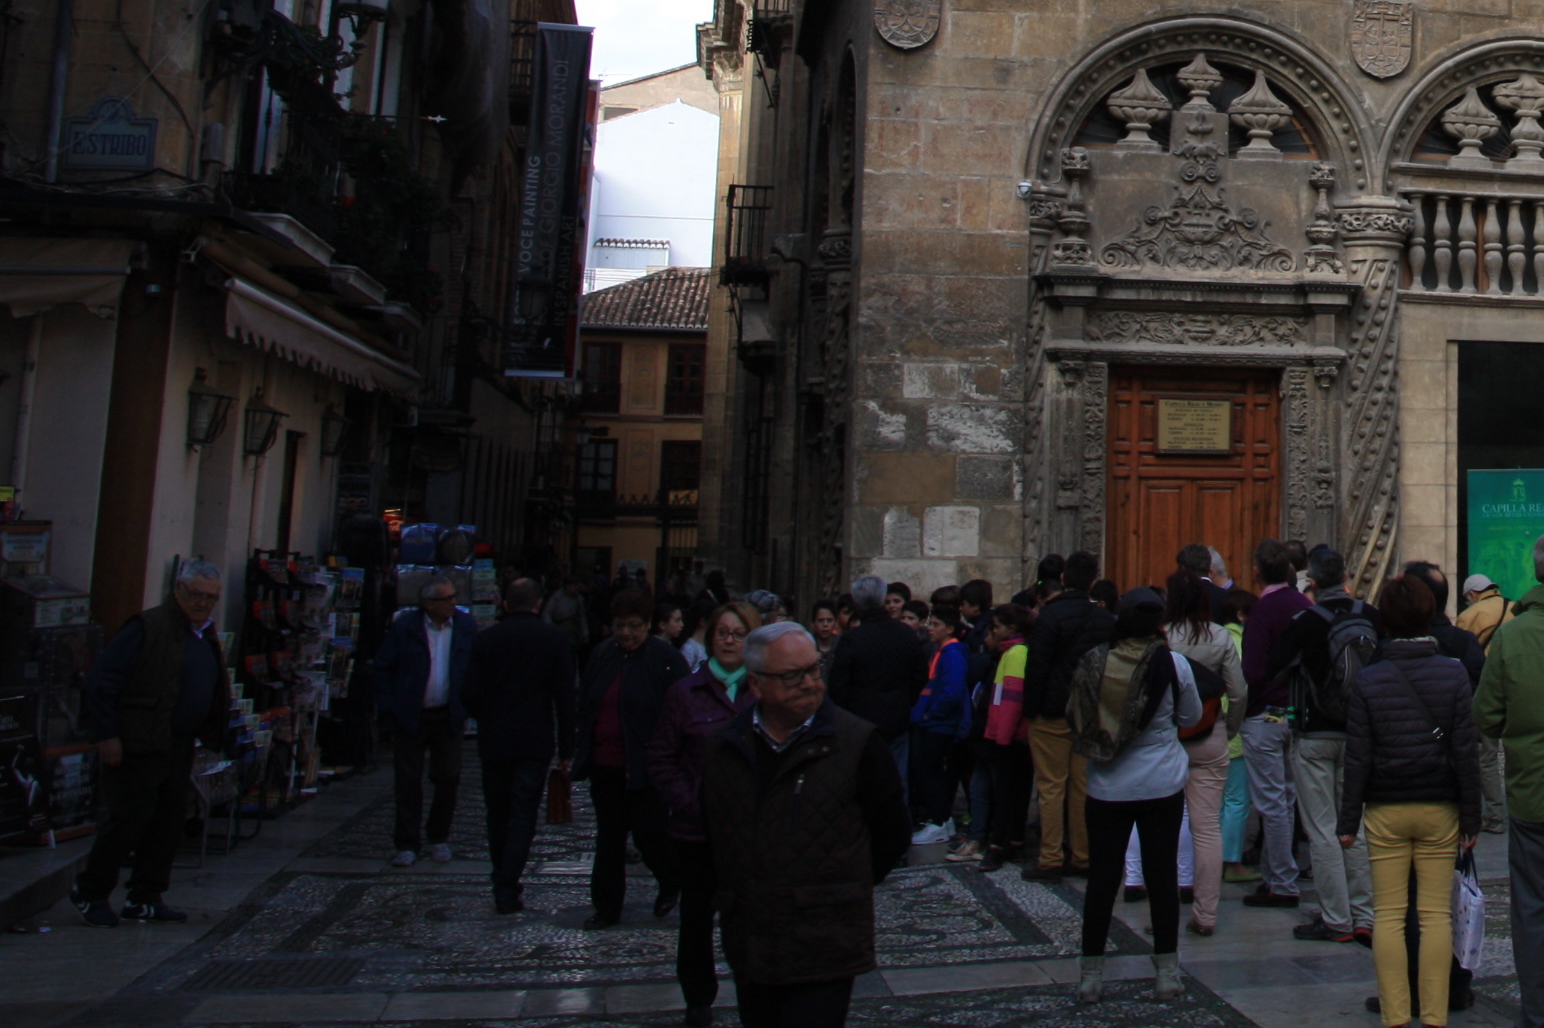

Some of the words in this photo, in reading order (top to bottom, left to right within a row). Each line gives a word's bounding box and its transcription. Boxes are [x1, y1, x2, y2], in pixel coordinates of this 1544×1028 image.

[548, 60, 569, 145] MORANDI
[72, 131, 147, 157] ESTRIBO
[522, 155, 541, 227] PAINTING
[540, 153, 561, 234] GIORGIO
[555, 247, 572, 308] SPANISH
[1482, 503, 1526, 514] CAPILLA
